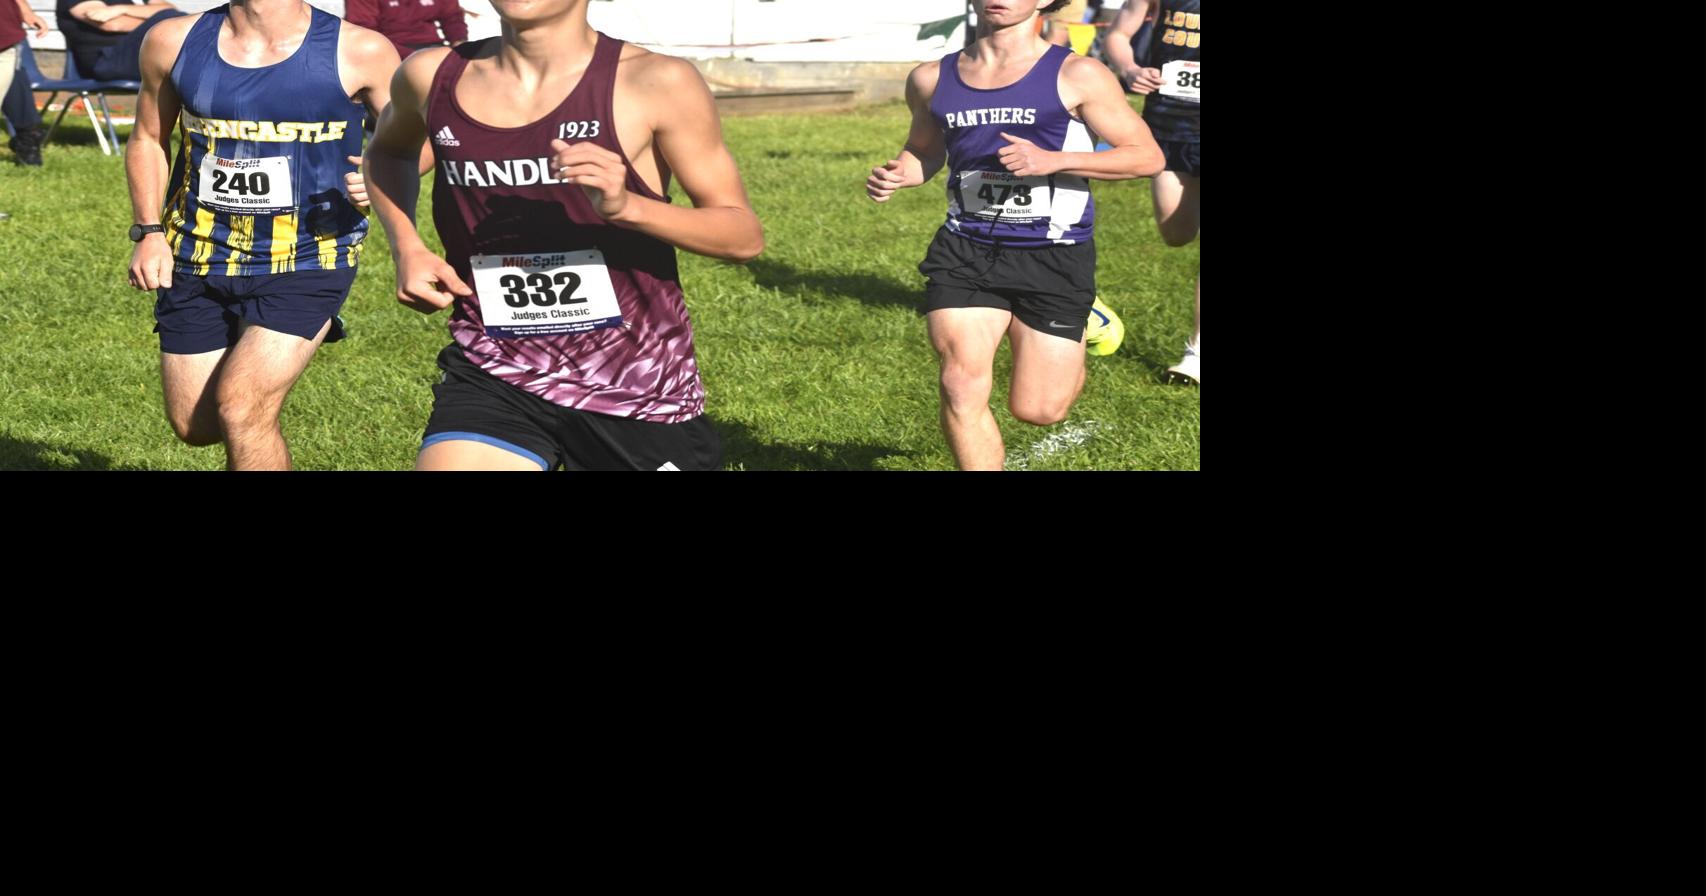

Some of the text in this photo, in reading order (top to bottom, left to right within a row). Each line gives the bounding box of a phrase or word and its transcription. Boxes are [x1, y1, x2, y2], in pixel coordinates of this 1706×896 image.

[1164, 10, 1200, 30] LOU
[945, 107, 1037, 129] PANTHERS
[558, 121, 600, 139] 1923
[216, 157, 261, 170] MileSplit
[442, 157, 569, 187] HANDL
[212, 169, 270, 196] 240
[214, 194, 271, 205] Judges Classic
[977, 182, 1033, 207] 473
[1005, 207, 1033, 215] Classic
[502, 254, 566, 269] MileSplit
[500, 271, 588, 308] 332
[511, 307, 591, 321] Judges Classic
